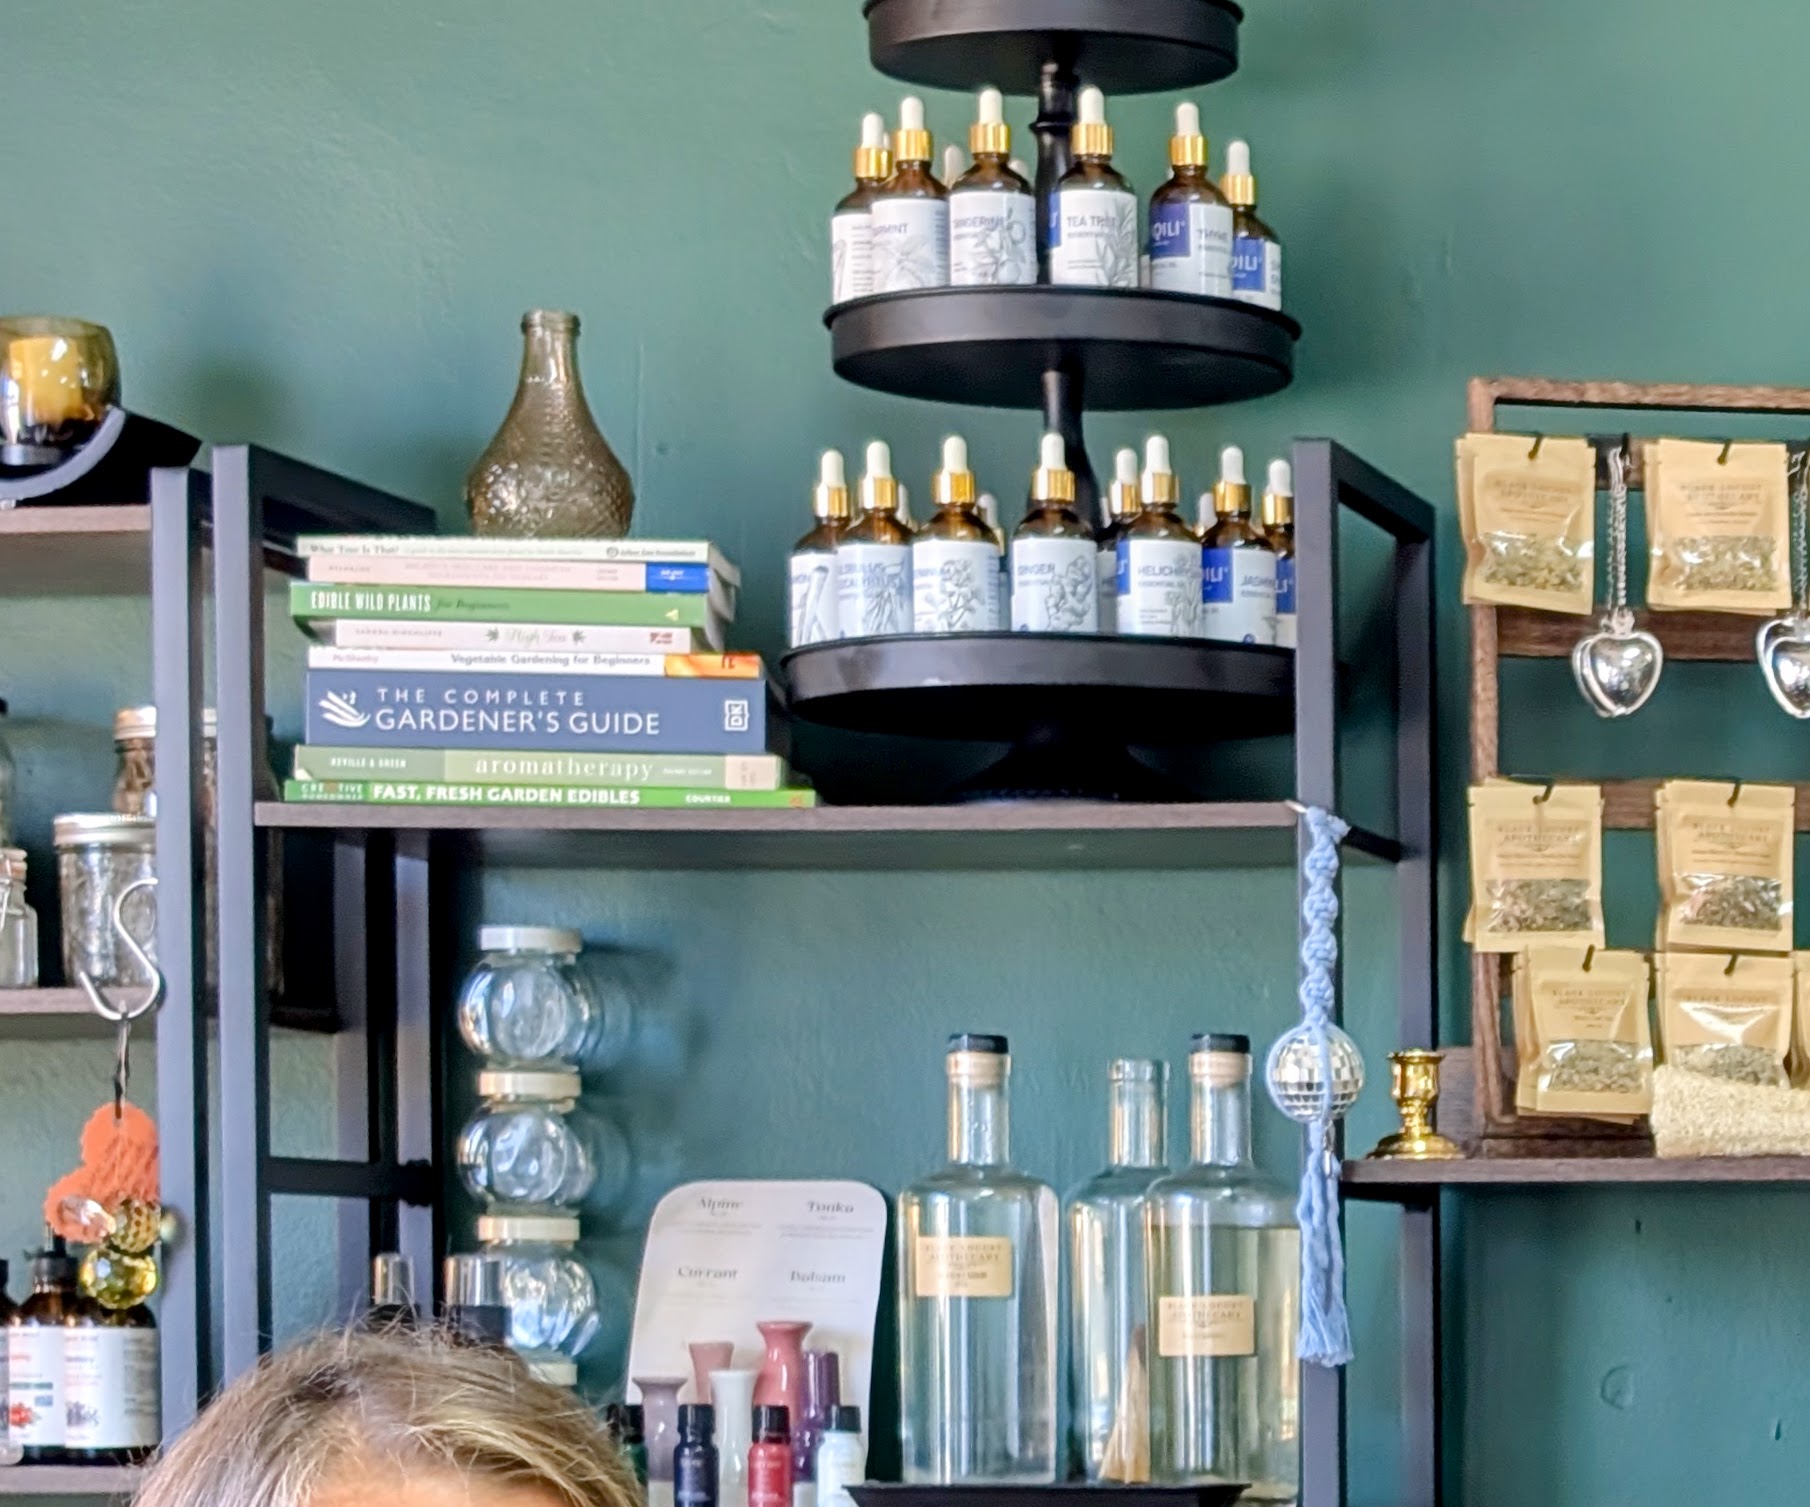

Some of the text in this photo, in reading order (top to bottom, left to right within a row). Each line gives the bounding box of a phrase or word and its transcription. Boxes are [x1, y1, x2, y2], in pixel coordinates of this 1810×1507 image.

[311, 591, 350, 611] EDIBLE
[355, 592, 383, 611] WILD
[388, 593, 431, 613] PLANTS
[451, 653, 650, 668] Vegetable Gardening for Beginners
[377, 688, 584, 706] THE COMPLETE
[375, 708, 660, 735] GARDENER'S GUIDE
[475, 756, 654, 781] aromatherapy
[373, 783, 641, 805] FAST, FRESH GARDEN EDIBLES
